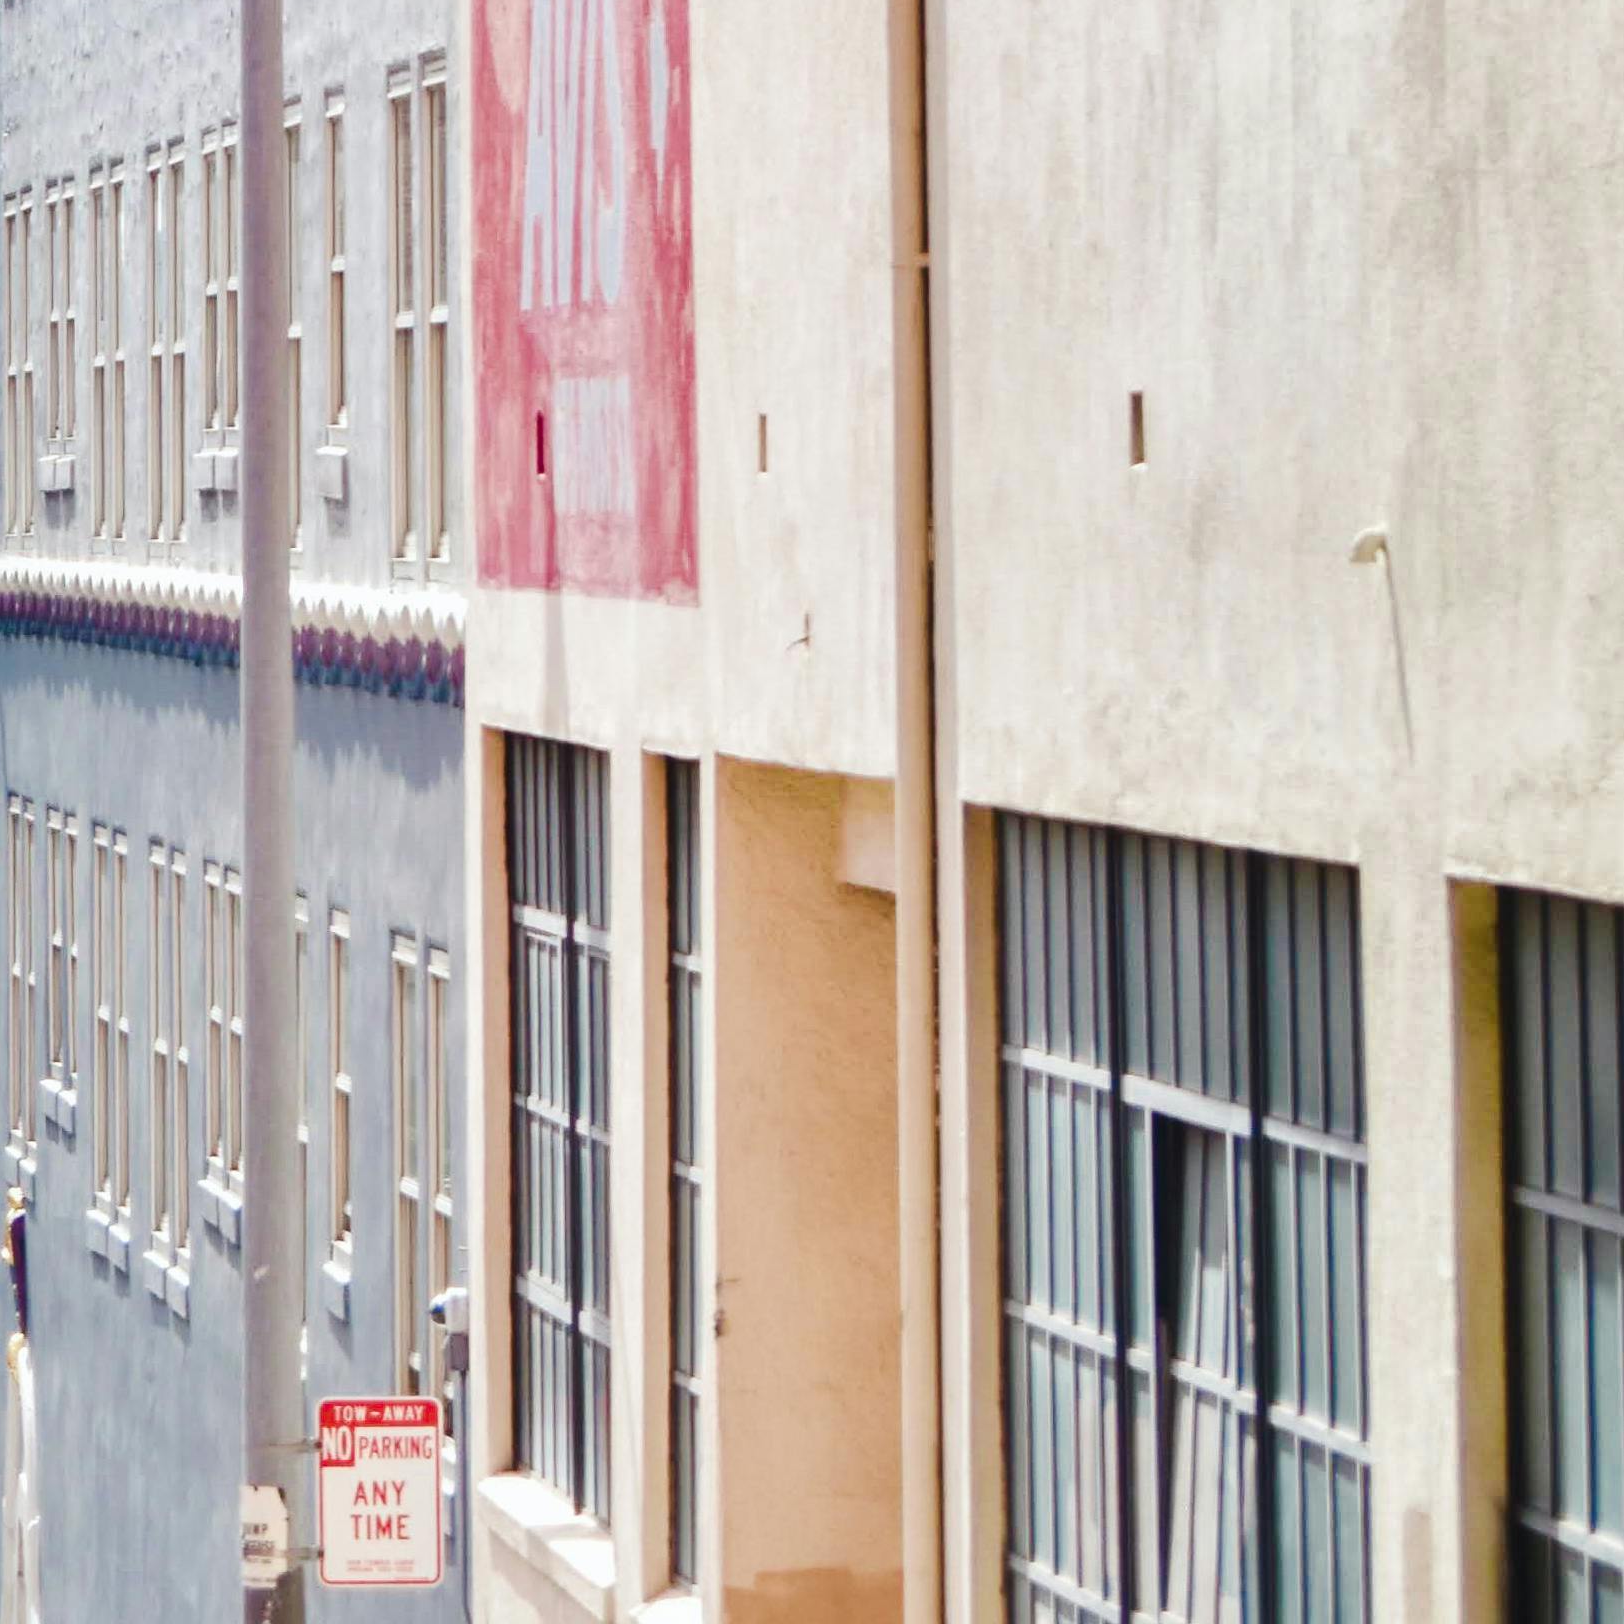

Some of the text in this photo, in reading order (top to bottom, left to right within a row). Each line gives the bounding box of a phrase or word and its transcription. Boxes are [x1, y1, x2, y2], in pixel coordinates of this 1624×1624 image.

[322, 1426, 433, 1460] NO PARKING
[353, 1481, 405, 1506] ANY
[350, 1514, 411, 1540] TIME
